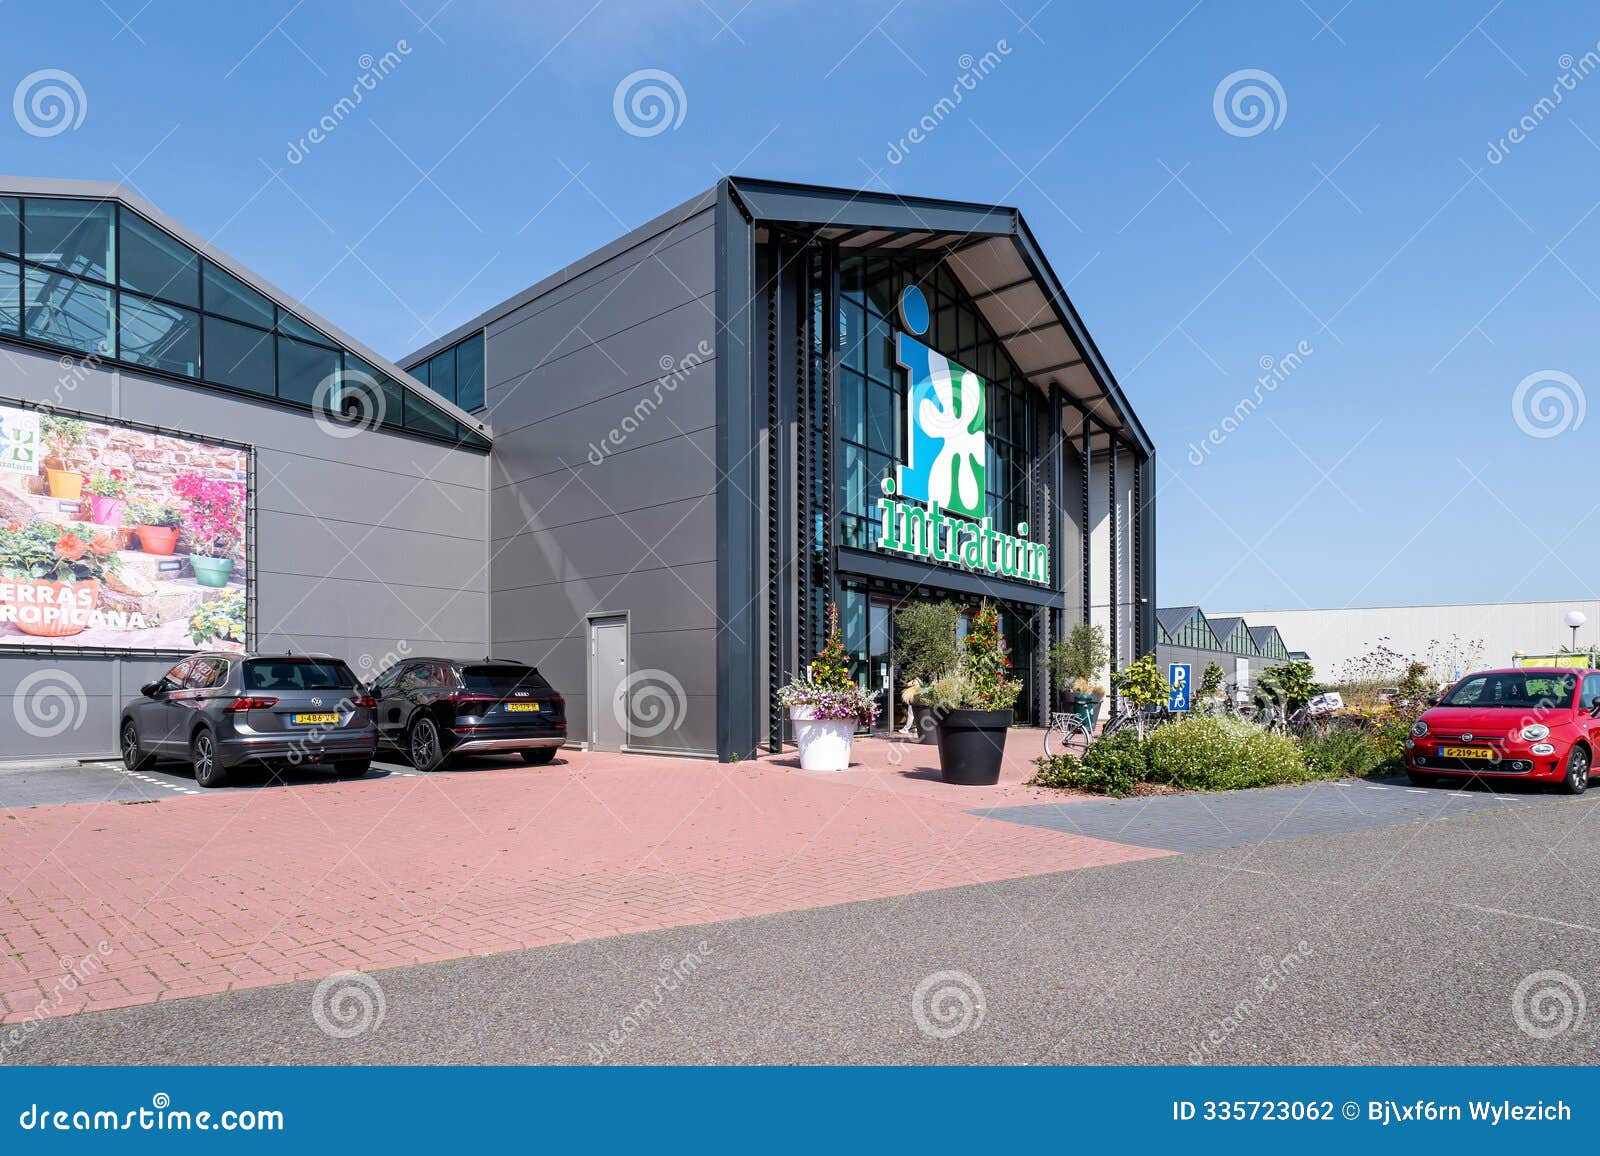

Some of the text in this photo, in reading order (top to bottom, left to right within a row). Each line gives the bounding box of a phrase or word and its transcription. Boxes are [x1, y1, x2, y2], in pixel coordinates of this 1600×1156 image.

[0, 462, 33, 471] ratuin
[878, 477, 1051, 584] intratuin
[1174, 667, 1186, 685] P
[1447, 748, 1488, 758] G-219-LG
